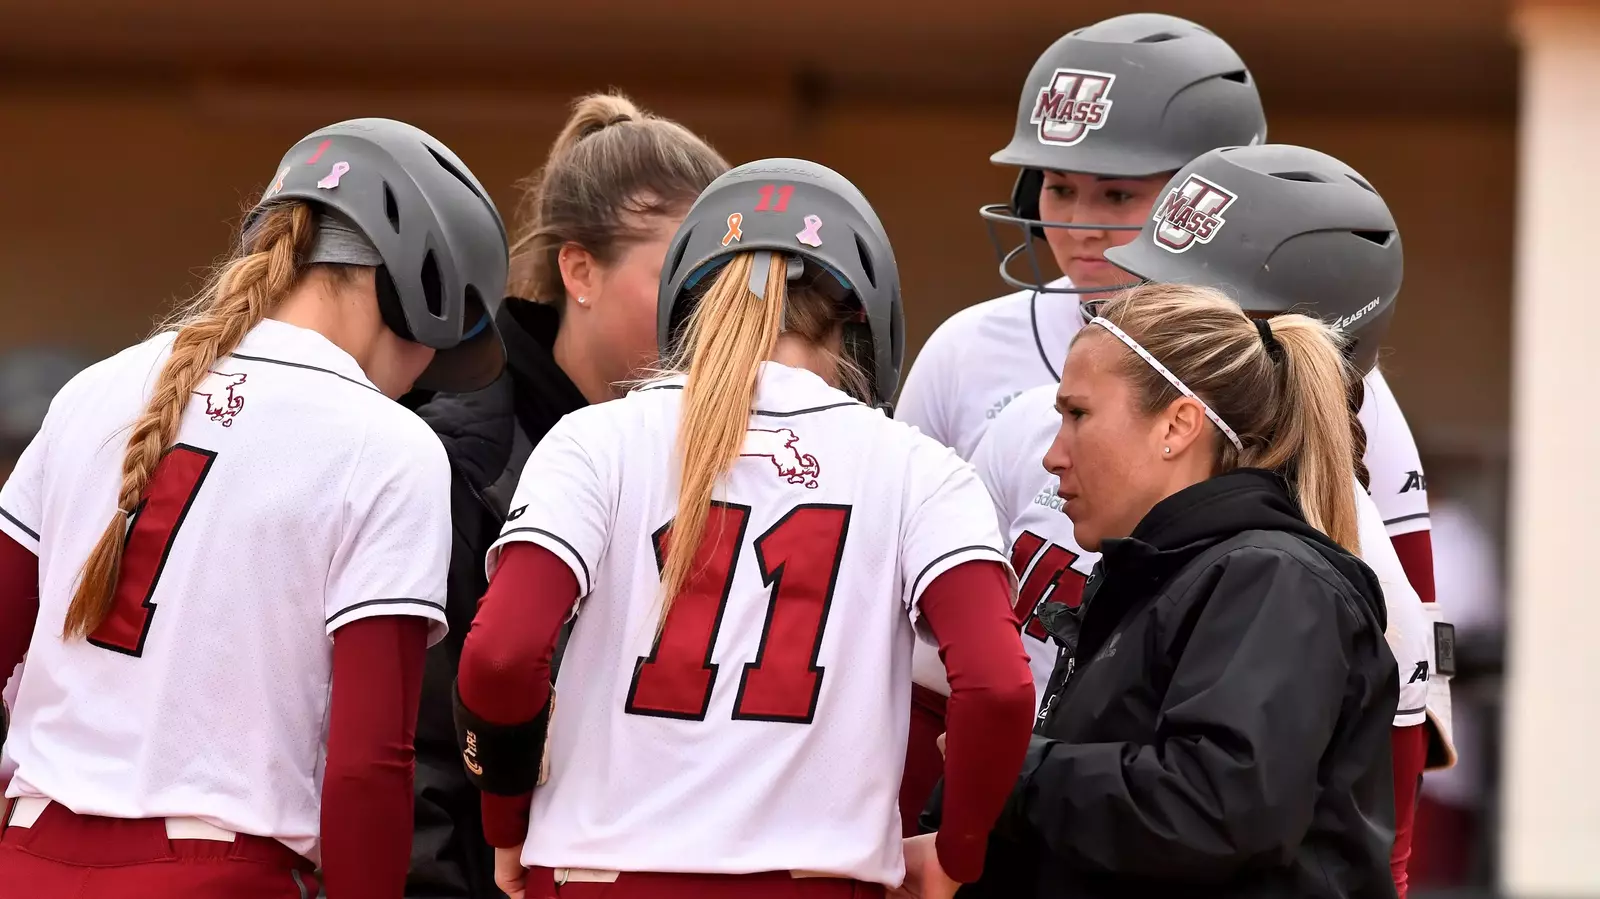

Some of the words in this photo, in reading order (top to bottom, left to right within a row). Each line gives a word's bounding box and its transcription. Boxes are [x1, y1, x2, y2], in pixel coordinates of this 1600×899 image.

[304, 138, 332, 165] 1
[754, 184, 796, 213] 11
[1342, 296, 1380, 328] EASTON
[86, 442, 219, 658] 1
[625, 499, 853, 725] 11
